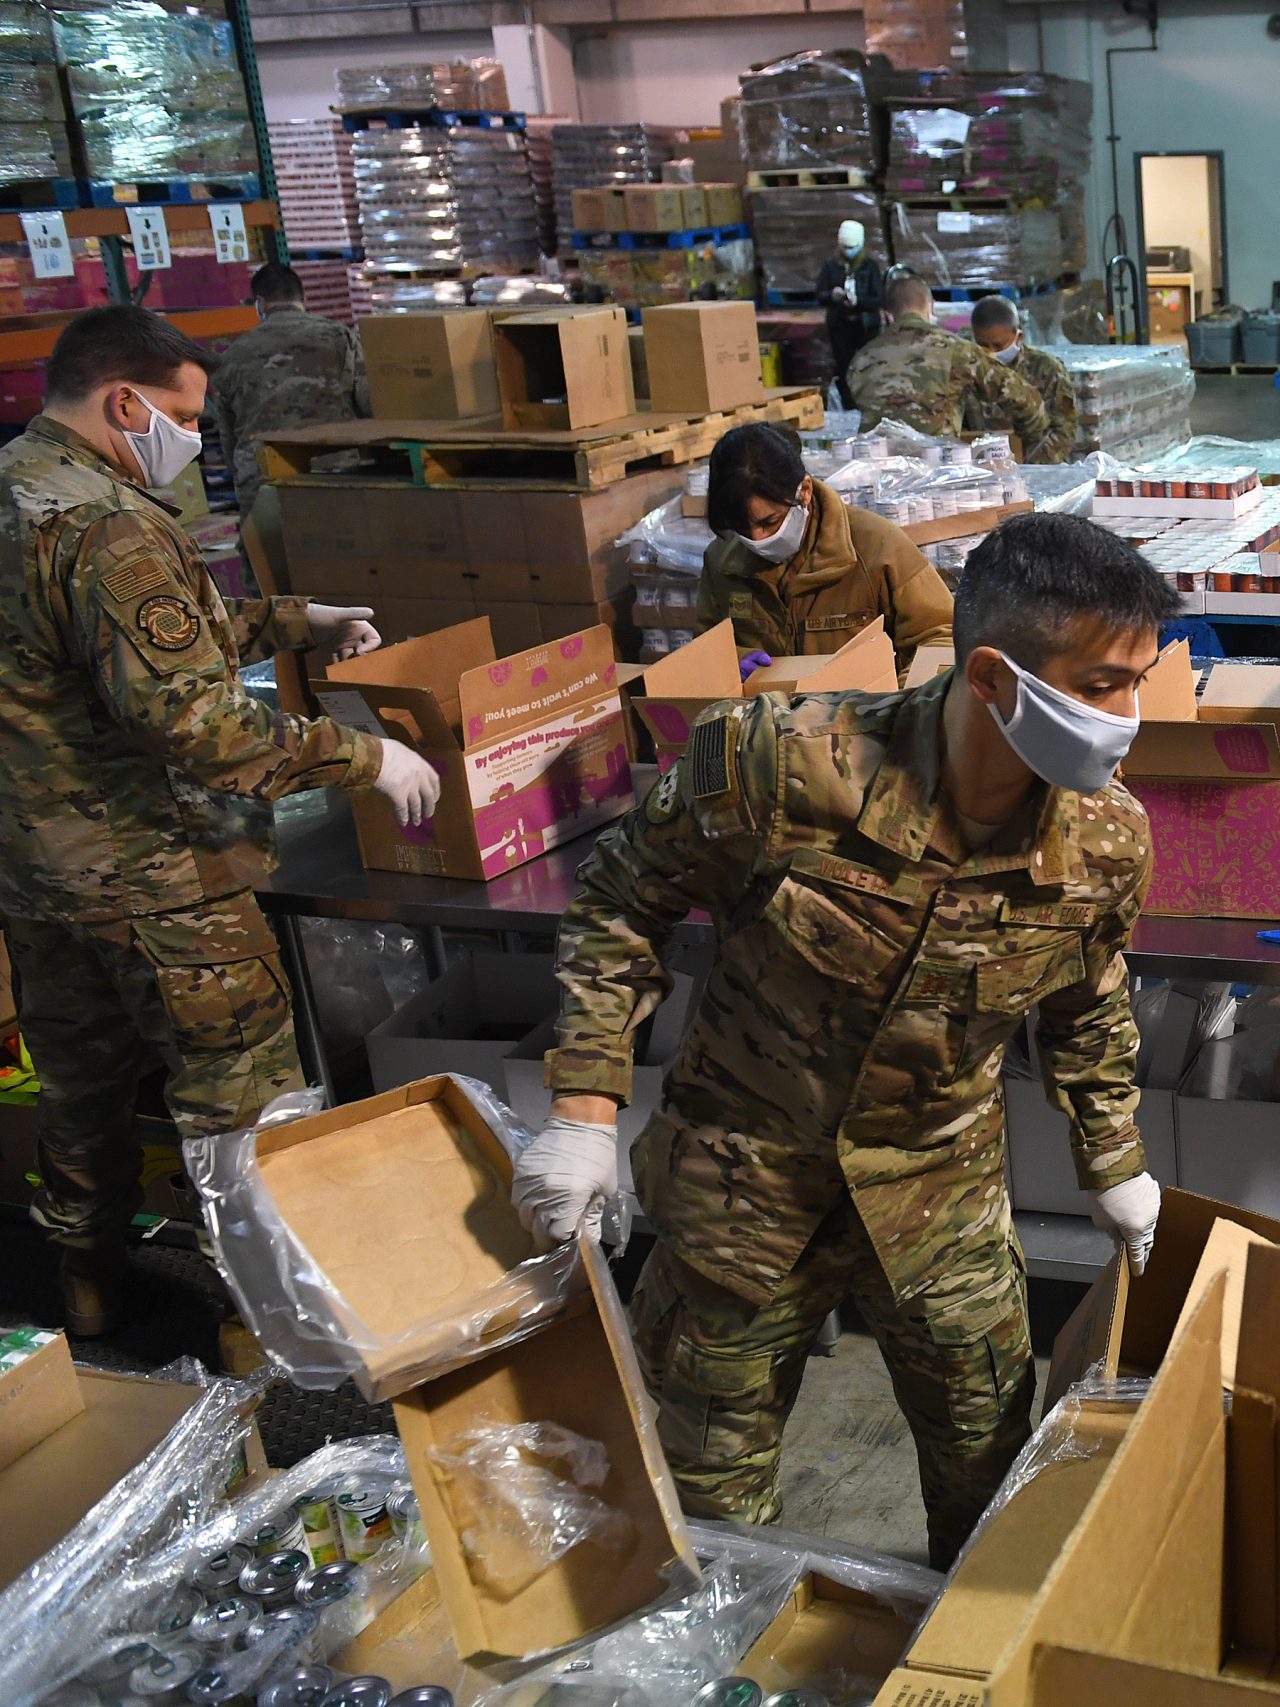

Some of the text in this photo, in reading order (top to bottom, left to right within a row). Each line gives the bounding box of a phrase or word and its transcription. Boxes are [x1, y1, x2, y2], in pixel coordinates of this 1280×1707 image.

[485, 673, 598, 724] We can't wait to meet you!
[474, 756, 487, 769] By
[488, 739, 527, 759] enjoying
[528, 732, 545, 745] this
[545, 726, 580, 744] produce
[1060, 906, 1091, 925] FORCE
